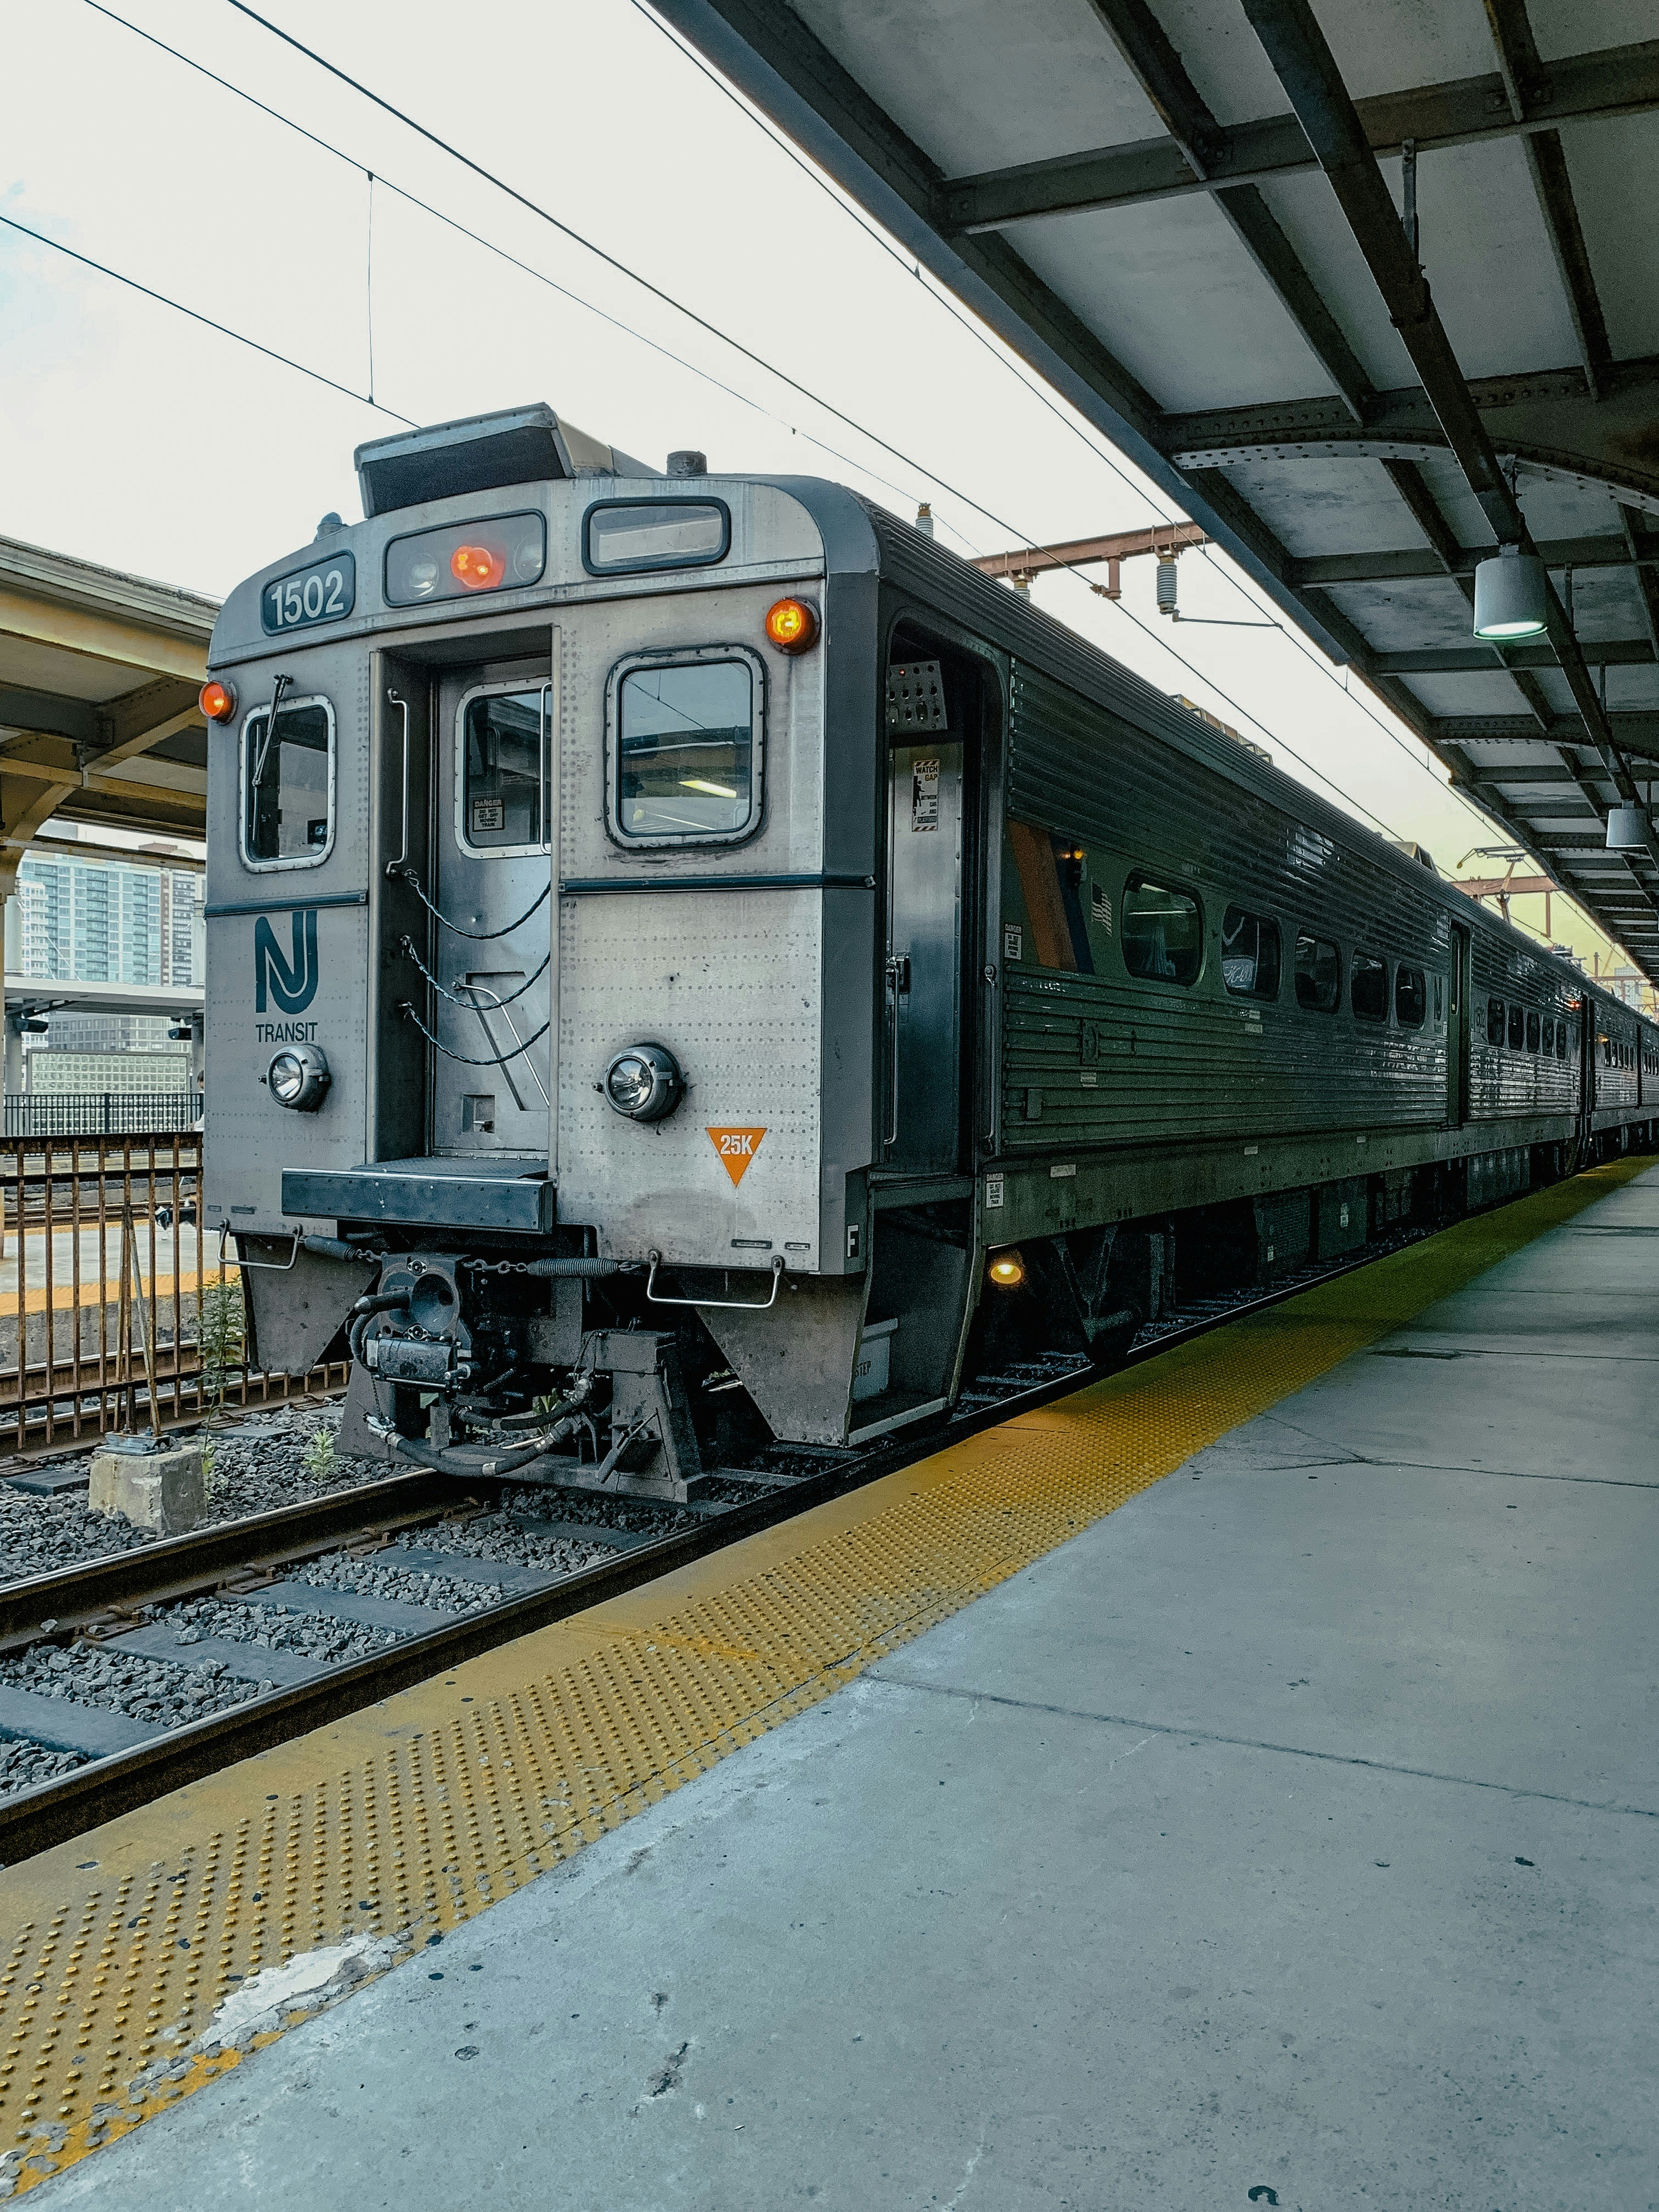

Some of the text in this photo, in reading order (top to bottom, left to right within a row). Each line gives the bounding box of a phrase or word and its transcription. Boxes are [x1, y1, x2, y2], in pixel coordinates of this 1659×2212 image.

[271, 570, 344, 625] 1502
[916, 766, 938, 774] WATCH
[475, 799, 501, 807] DANGER
[1005, 924, 1022, 934] DANGER
[255, 910, 318, 1015] NJ
[256, 1022, 318, 1042] TRANSIT
[720, 1135, 753, 1155] 25K
[847, 1224, 859, 1257] F
[855, 1361, 871, 1377] STEP
